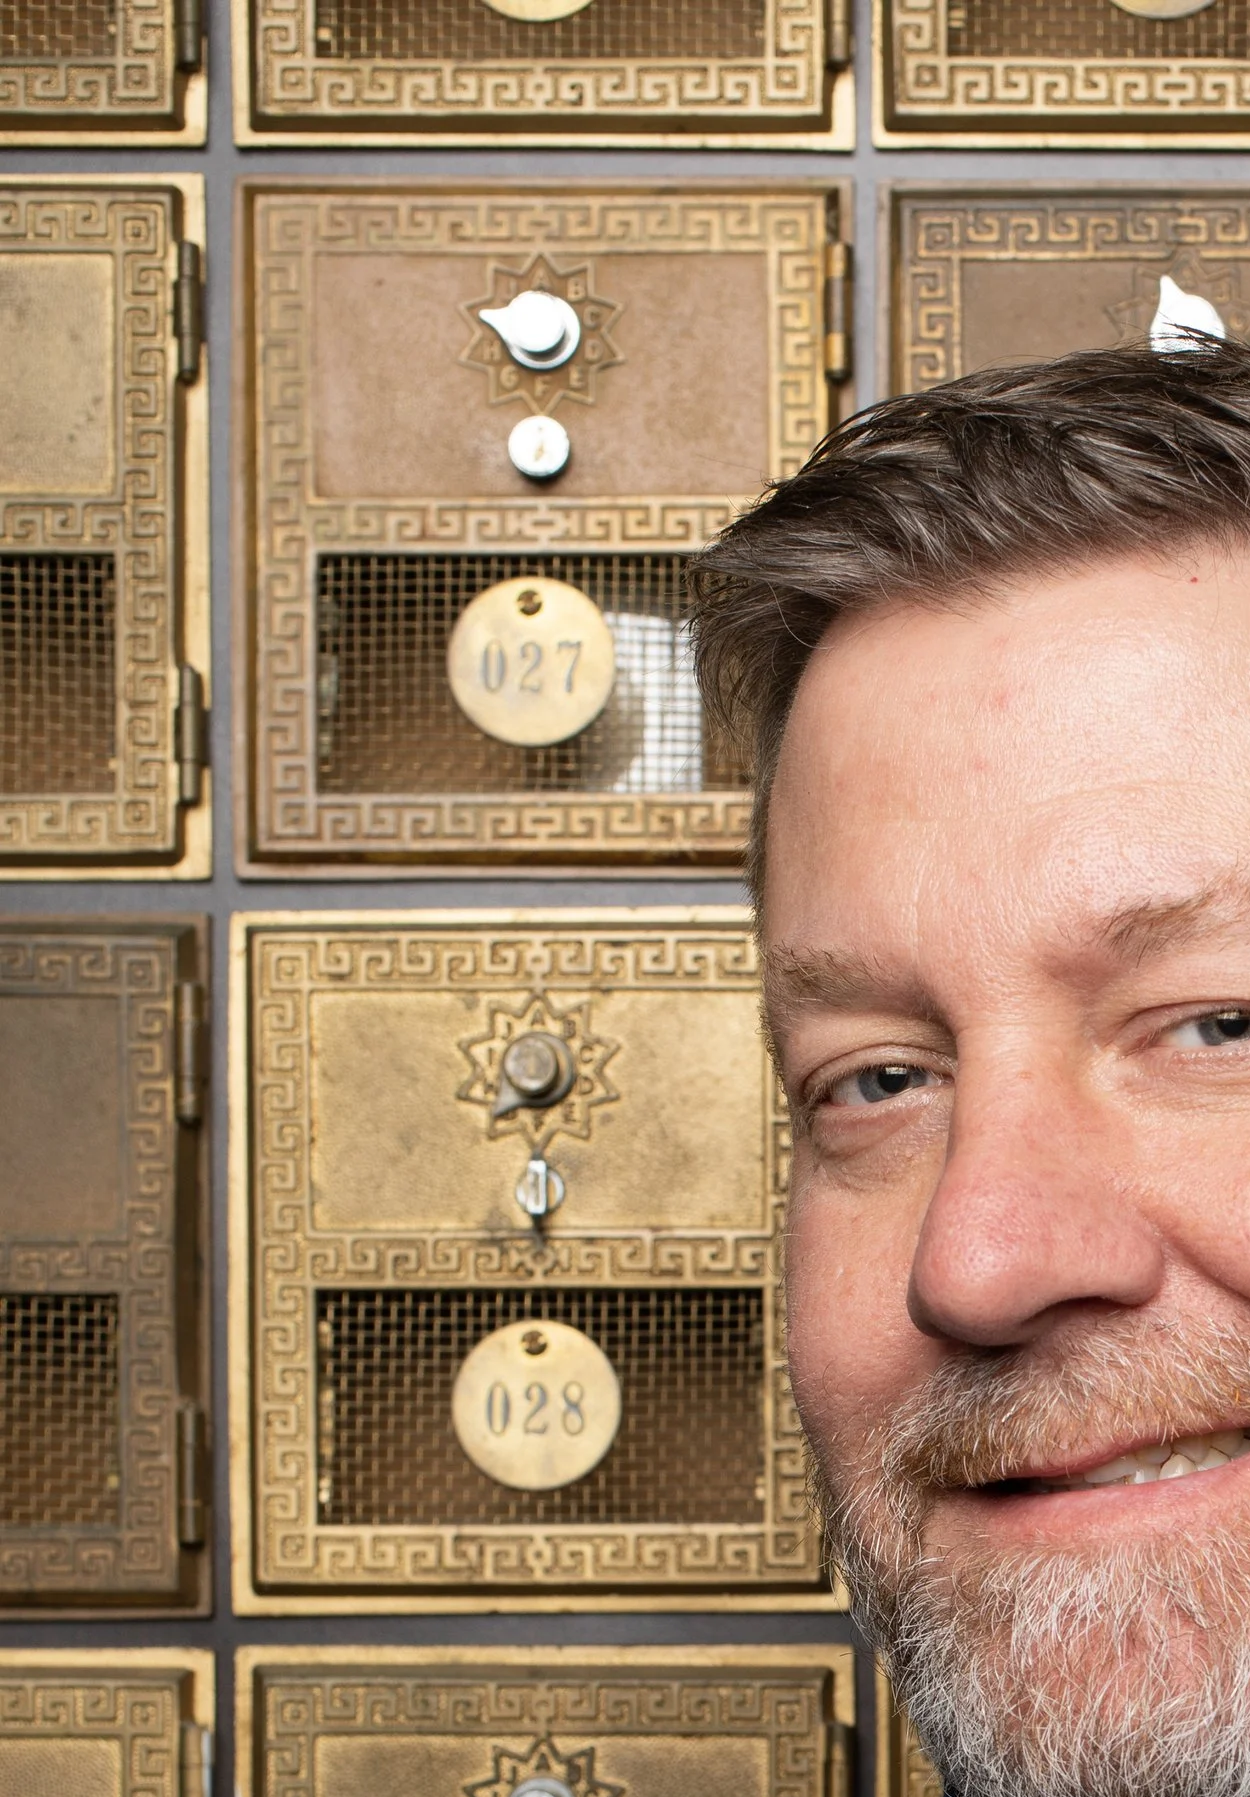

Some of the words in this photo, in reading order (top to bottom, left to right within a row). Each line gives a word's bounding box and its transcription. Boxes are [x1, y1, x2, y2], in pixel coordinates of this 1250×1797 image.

[566, 277, 586, 302] B
[582, 304, 601, 328] C
[482, 340, 501, 361] H
[583, 338, 603, 362] D
[534, 375, 553, 398] F
[568, 364, 584, 388] E
[480, 638, 584, 695] 027
[485, 1379, 586, 1437] 028
